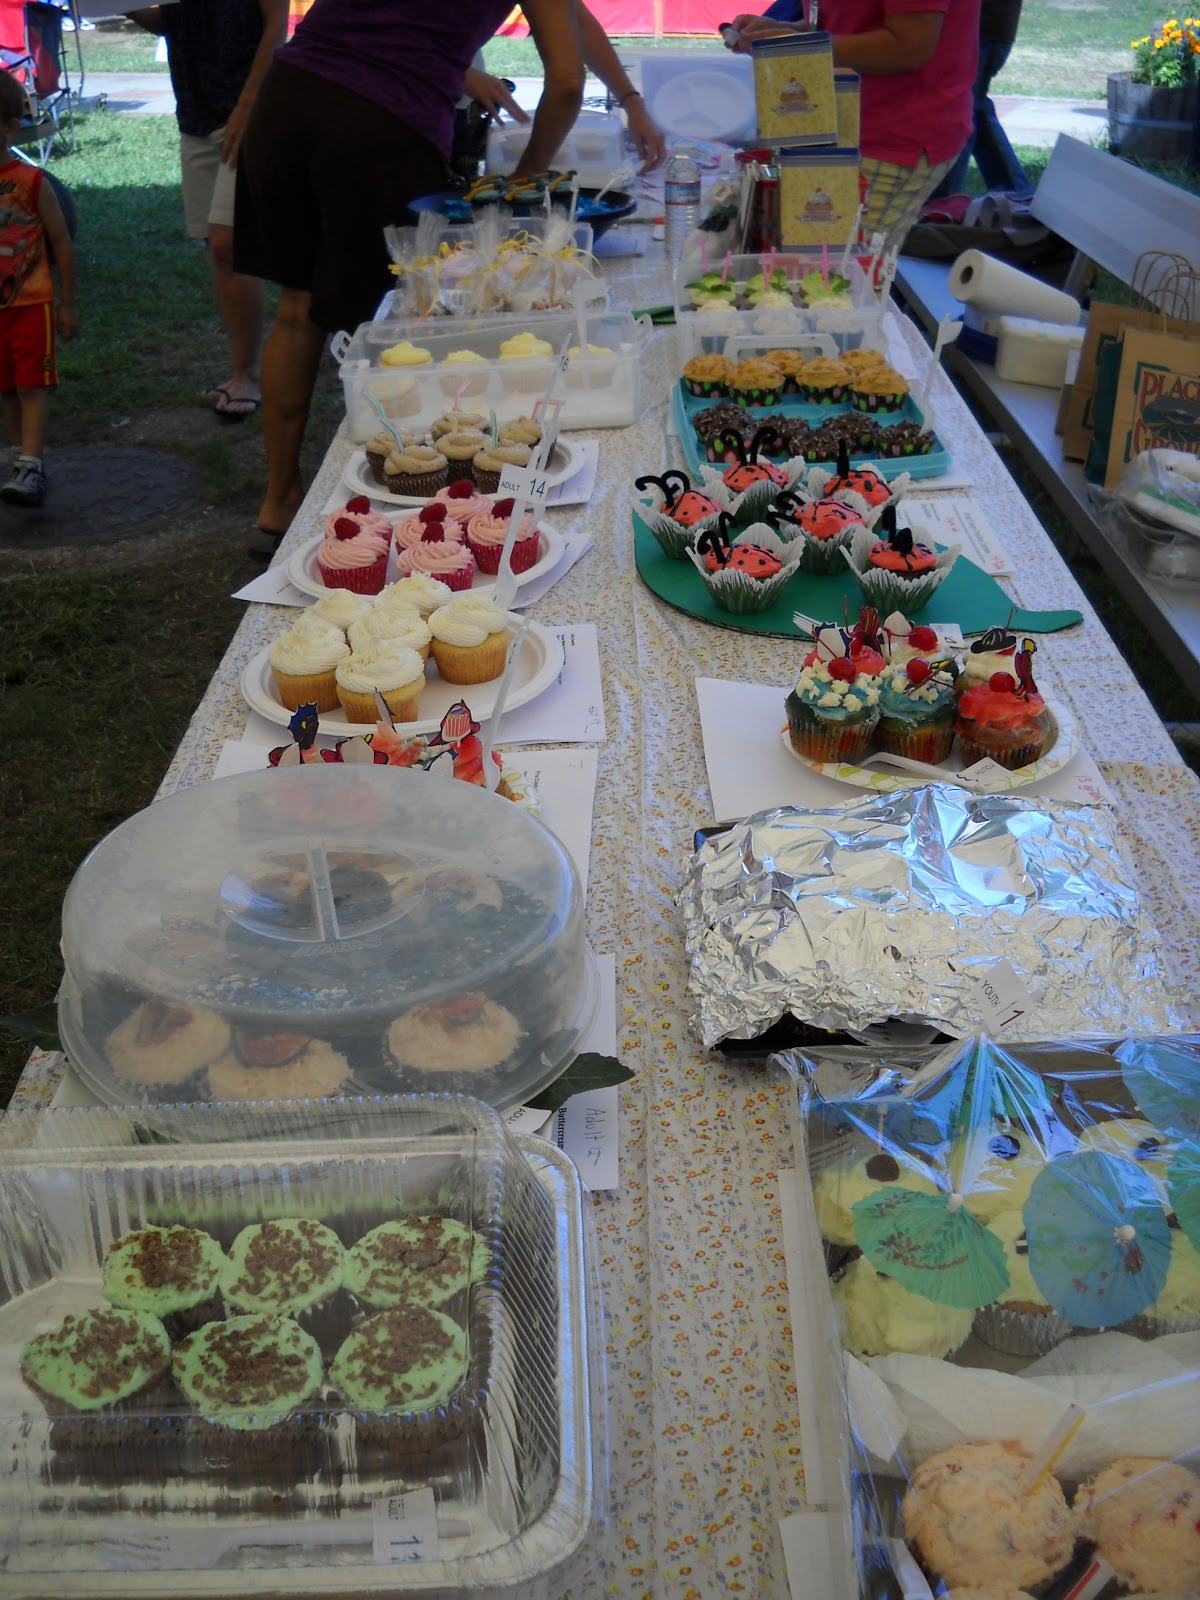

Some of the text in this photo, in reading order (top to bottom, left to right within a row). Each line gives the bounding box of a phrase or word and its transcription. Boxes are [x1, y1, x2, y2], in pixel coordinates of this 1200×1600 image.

[560, 356, 569, 372] 16
[1139, 370, 1200, 418] PLAC
[501, 478, 546, 498] ADULT 14
[981, 980, 1001, 1008] YOUTH
[584, 1108, 606, 1141] Adult
